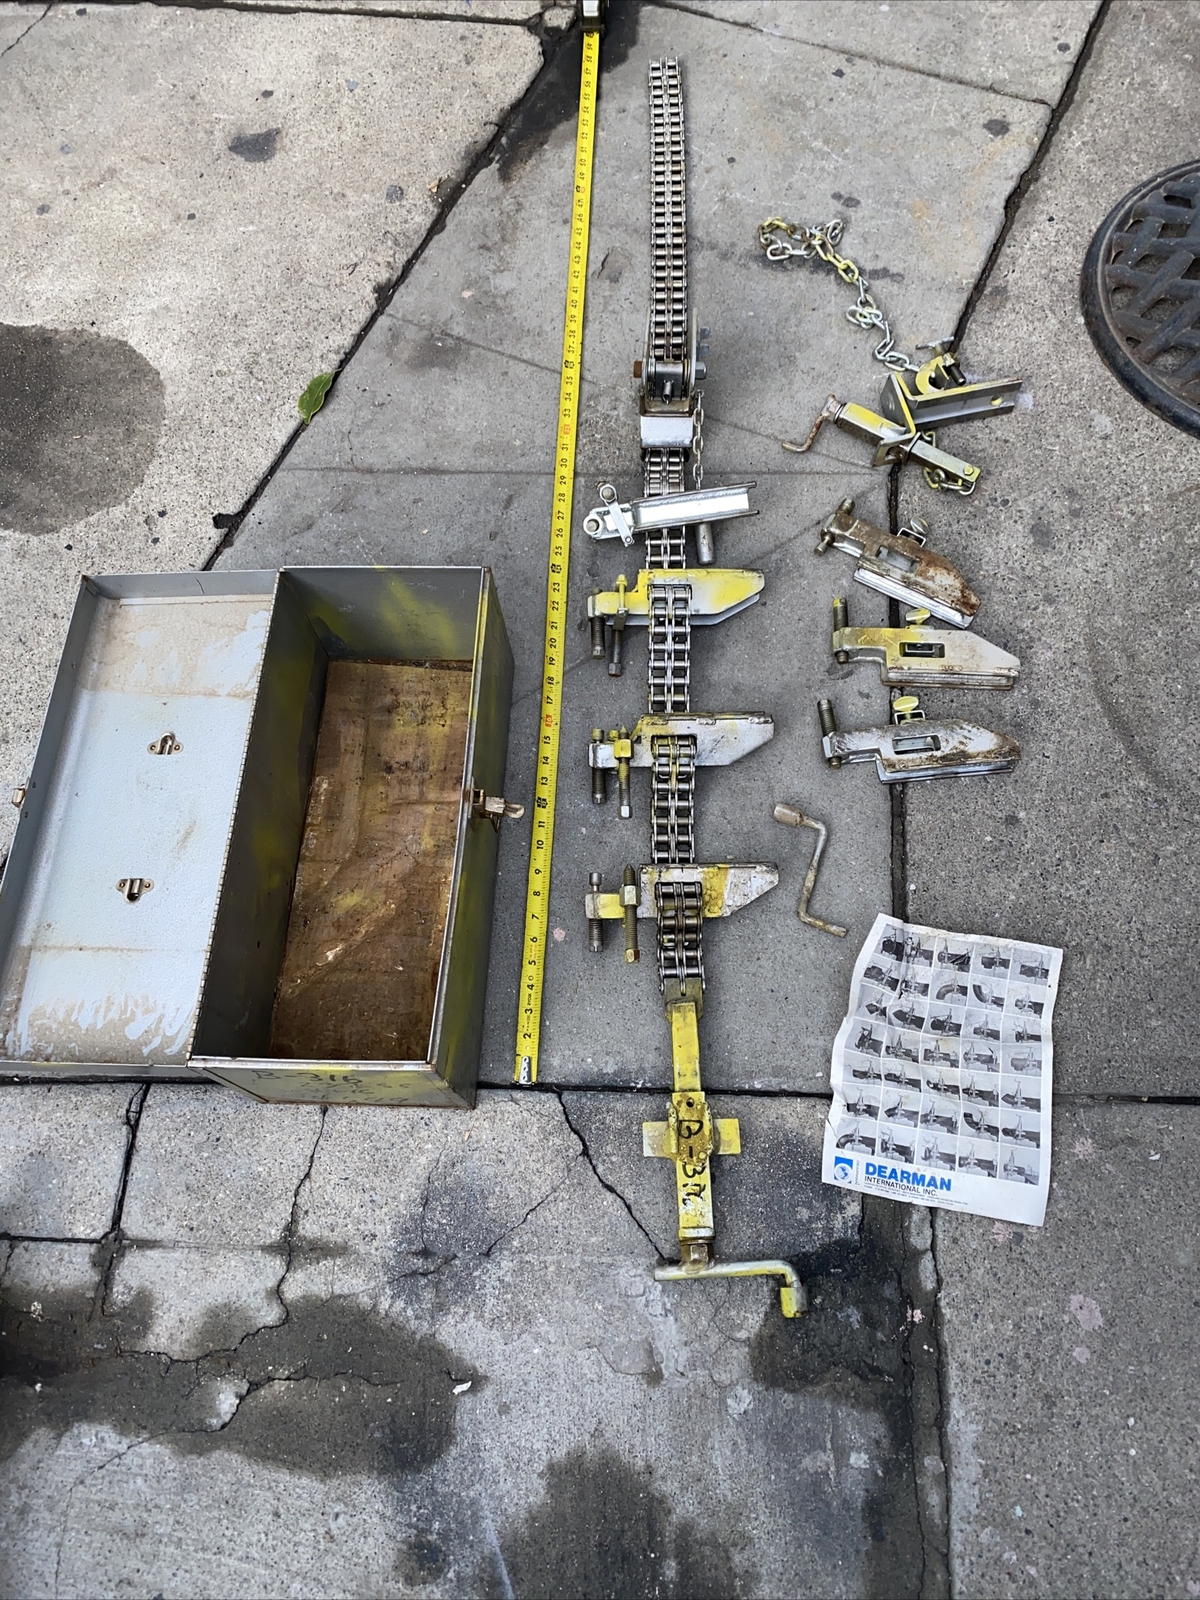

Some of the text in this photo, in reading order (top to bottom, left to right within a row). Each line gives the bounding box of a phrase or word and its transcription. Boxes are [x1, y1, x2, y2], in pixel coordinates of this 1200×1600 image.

[576, 227, 583, 236] 45
[575, 241, 582, 250] 44
[574, 255, 581, 265] 43
[573, 270, 580, 279] 42
[572, 286, 579, 294] 41
[571, 299, 578, 309] 40
[570, 314, 577, 324] 39
[569, 329, 576, 339] 38
[568, 345, 575, 354] 37
[566, 376, 573, 386] 35
[565, 392, 572, 402] 34
[564, 408, 571, 418] 33
[561, 443, 569, 451] 31
[560, 458, 568, 468] 30
[559, 475, 567, 486] 29
[558, 493, 566, 503] 28
[557, 510, 565, 520] 27
[556, 528, 564, 538] 26
[555, 546, 562, 556] 25
[553, 582, 560, 593] 23
[551, 600, 559, 612] 22
[550, 621, 558, 630] 21
[549, 637, 557, 649] 20
[548, 656, 556, 666] 19
[547, 676, 554, 686] 18
[546, 695, 553, 705] 17
[545, 717, 552, 725] 16
[543, 735, 551, 745] 15
[542, 756, 549, 765] 14
[540, 776, 548, 786] 13
[537, 820, 546, 828] 11
[536, 840, 544, 850] 10
[527, 983, 534, 991] 4
[865, 1162, 952, 1191] DEARMAN
[864, 1176, 920, 1193] INTERNATIONAL
[923, 1188, 938, 1196] INC.
